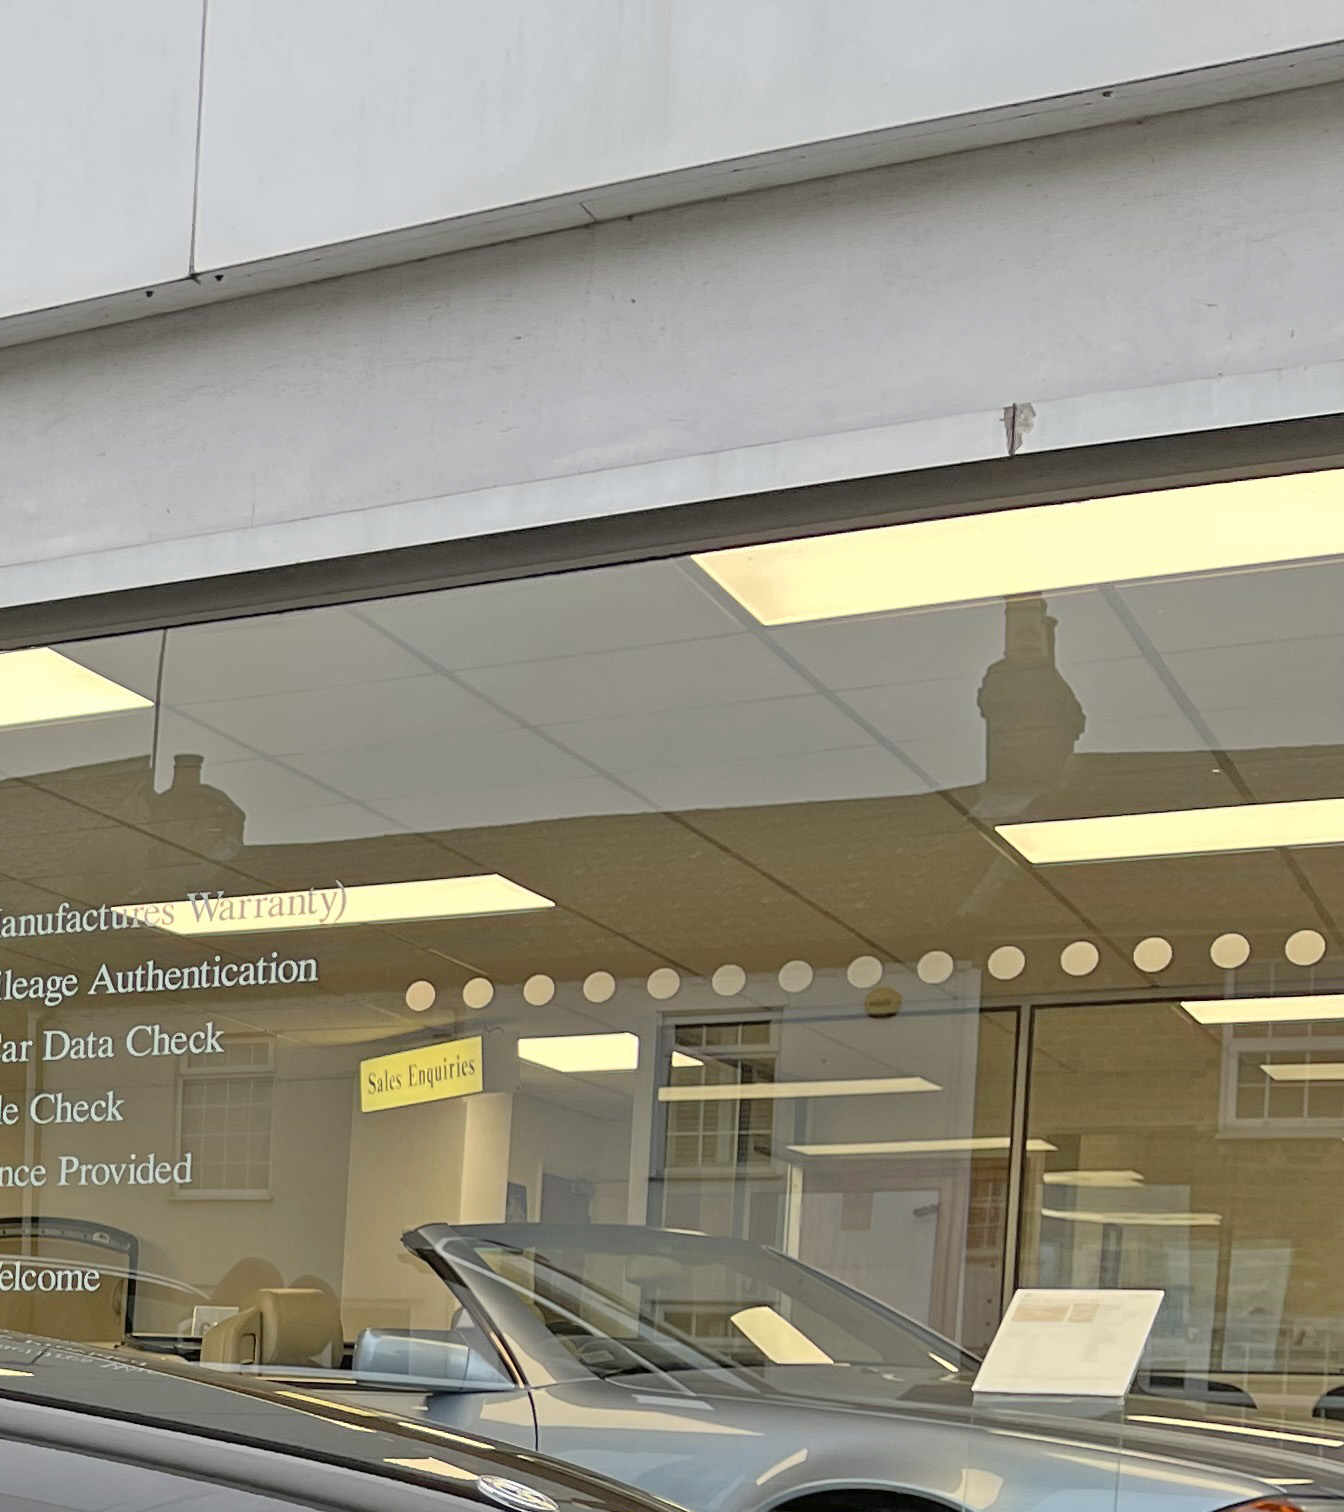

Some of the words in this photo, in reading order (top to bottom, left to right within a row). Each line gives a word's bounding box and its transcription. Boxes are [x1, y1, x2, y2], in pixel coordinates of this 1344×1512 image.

[187, 879, 346, 924] Warranty)
[87, 951, 319, 996] Authentication
[42, 1029, 115, 1062] Data
[125, 1022, 225, 1057] Check
[367, 1069, 402, 1096] Sales
[408, 1055, 476, 1089] Enquiries
[30, 1091, 125, 1123] Check
[58, 1153, 194, 1187] Provided
